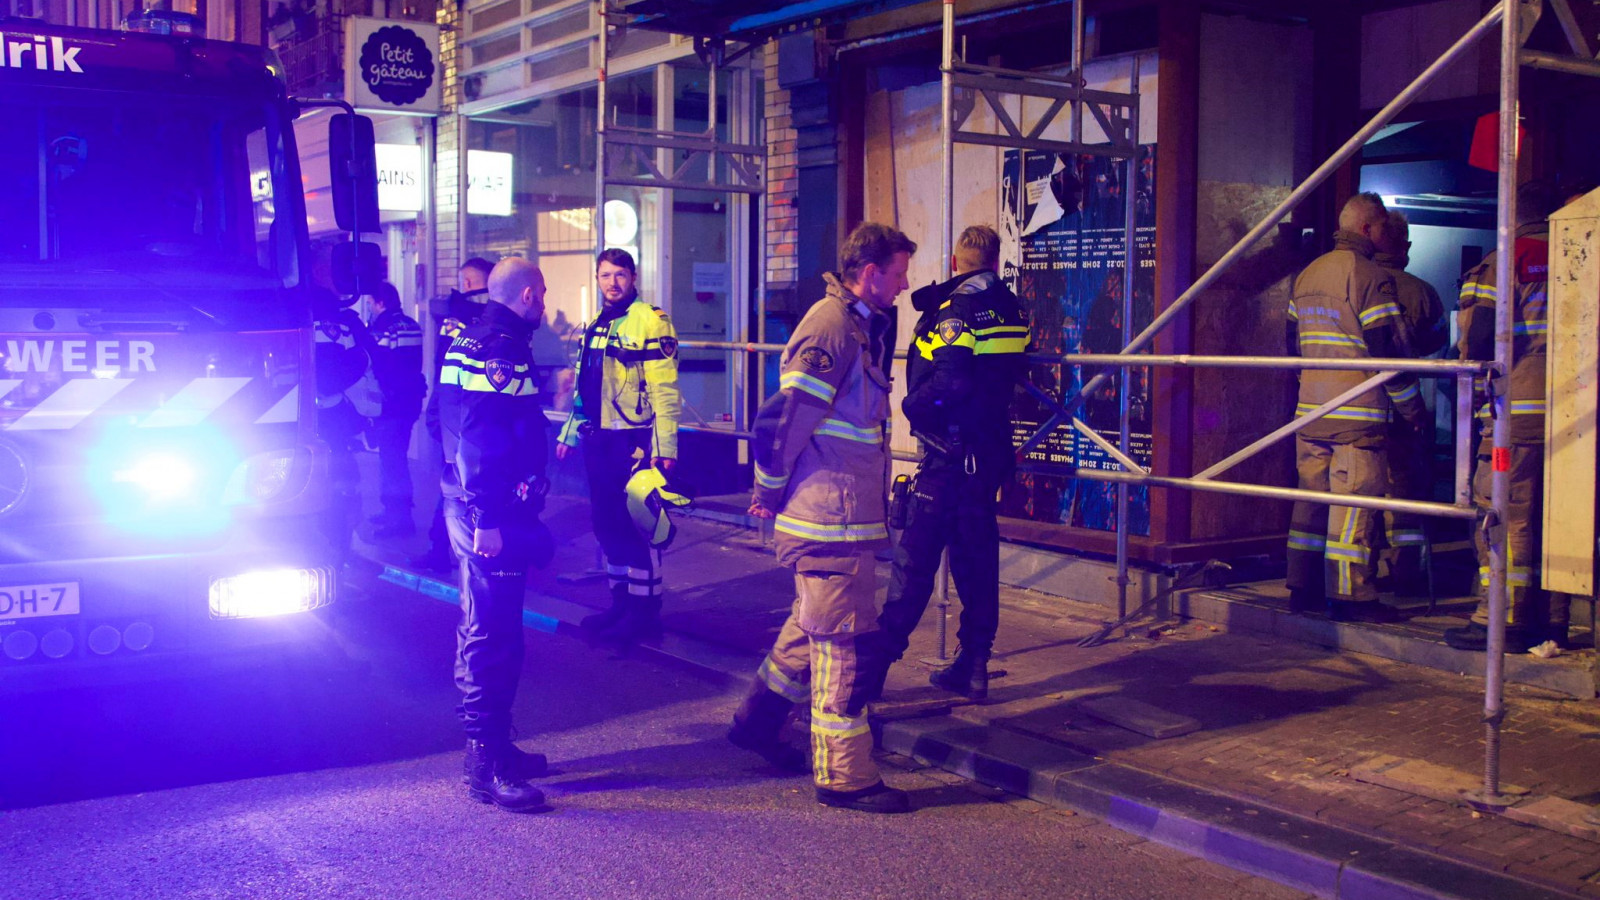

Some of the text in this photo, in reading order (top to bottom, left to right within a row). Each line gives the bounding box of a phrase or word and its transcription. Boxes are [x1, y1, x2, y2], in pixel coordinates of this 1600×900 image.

[380, 42, 414, 63] Petit
[370, 63, 426, 86] gâteau
[1052, 261, 1077, 270] PHASES
[6, 340, 157, 373] WEER
[1050, 454, 1074, 463] PHASES
